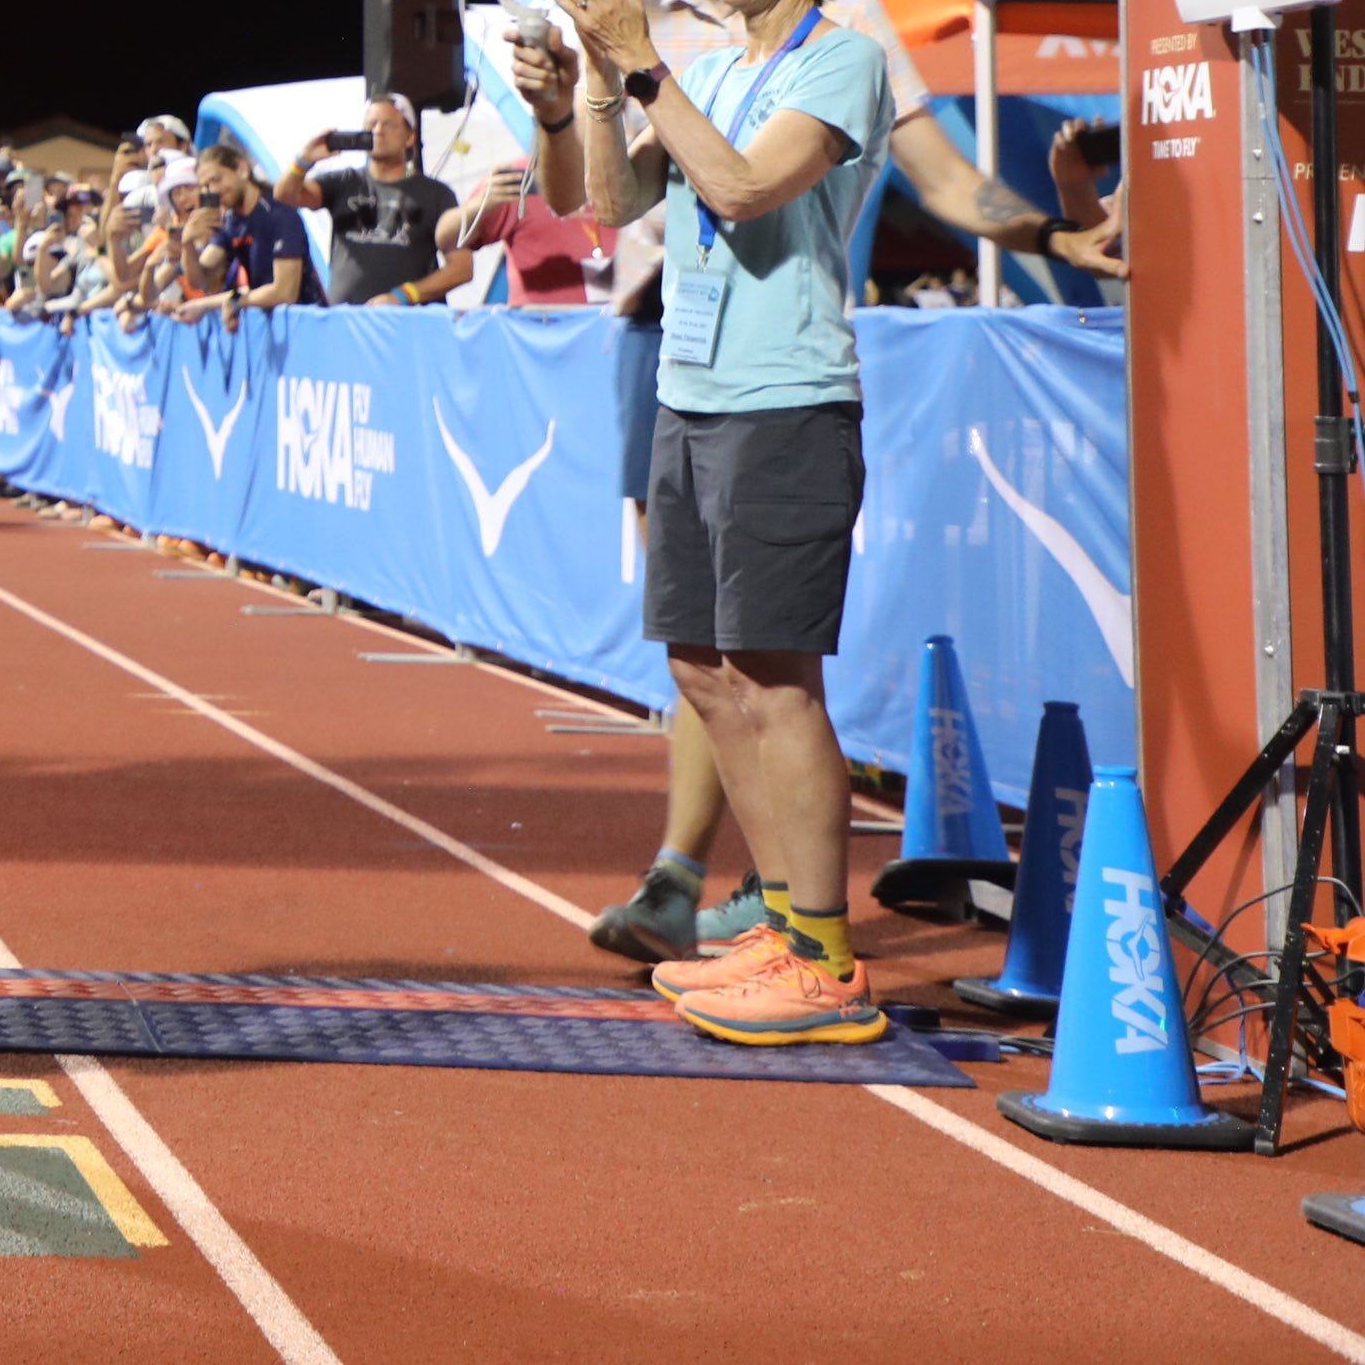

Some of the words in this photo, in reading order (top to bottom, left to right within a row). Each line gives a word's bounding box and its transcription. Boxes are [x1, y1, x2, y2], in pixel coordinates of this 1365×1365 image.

[1141, 61, 1213, 126] HOKA
[1152, 139, 1170, 159] TIME
[1171, 138, 1182, 158] TO
[277, 375, 354, 508] HOKA
[1102, 866, 1169, 1055] HOKA
